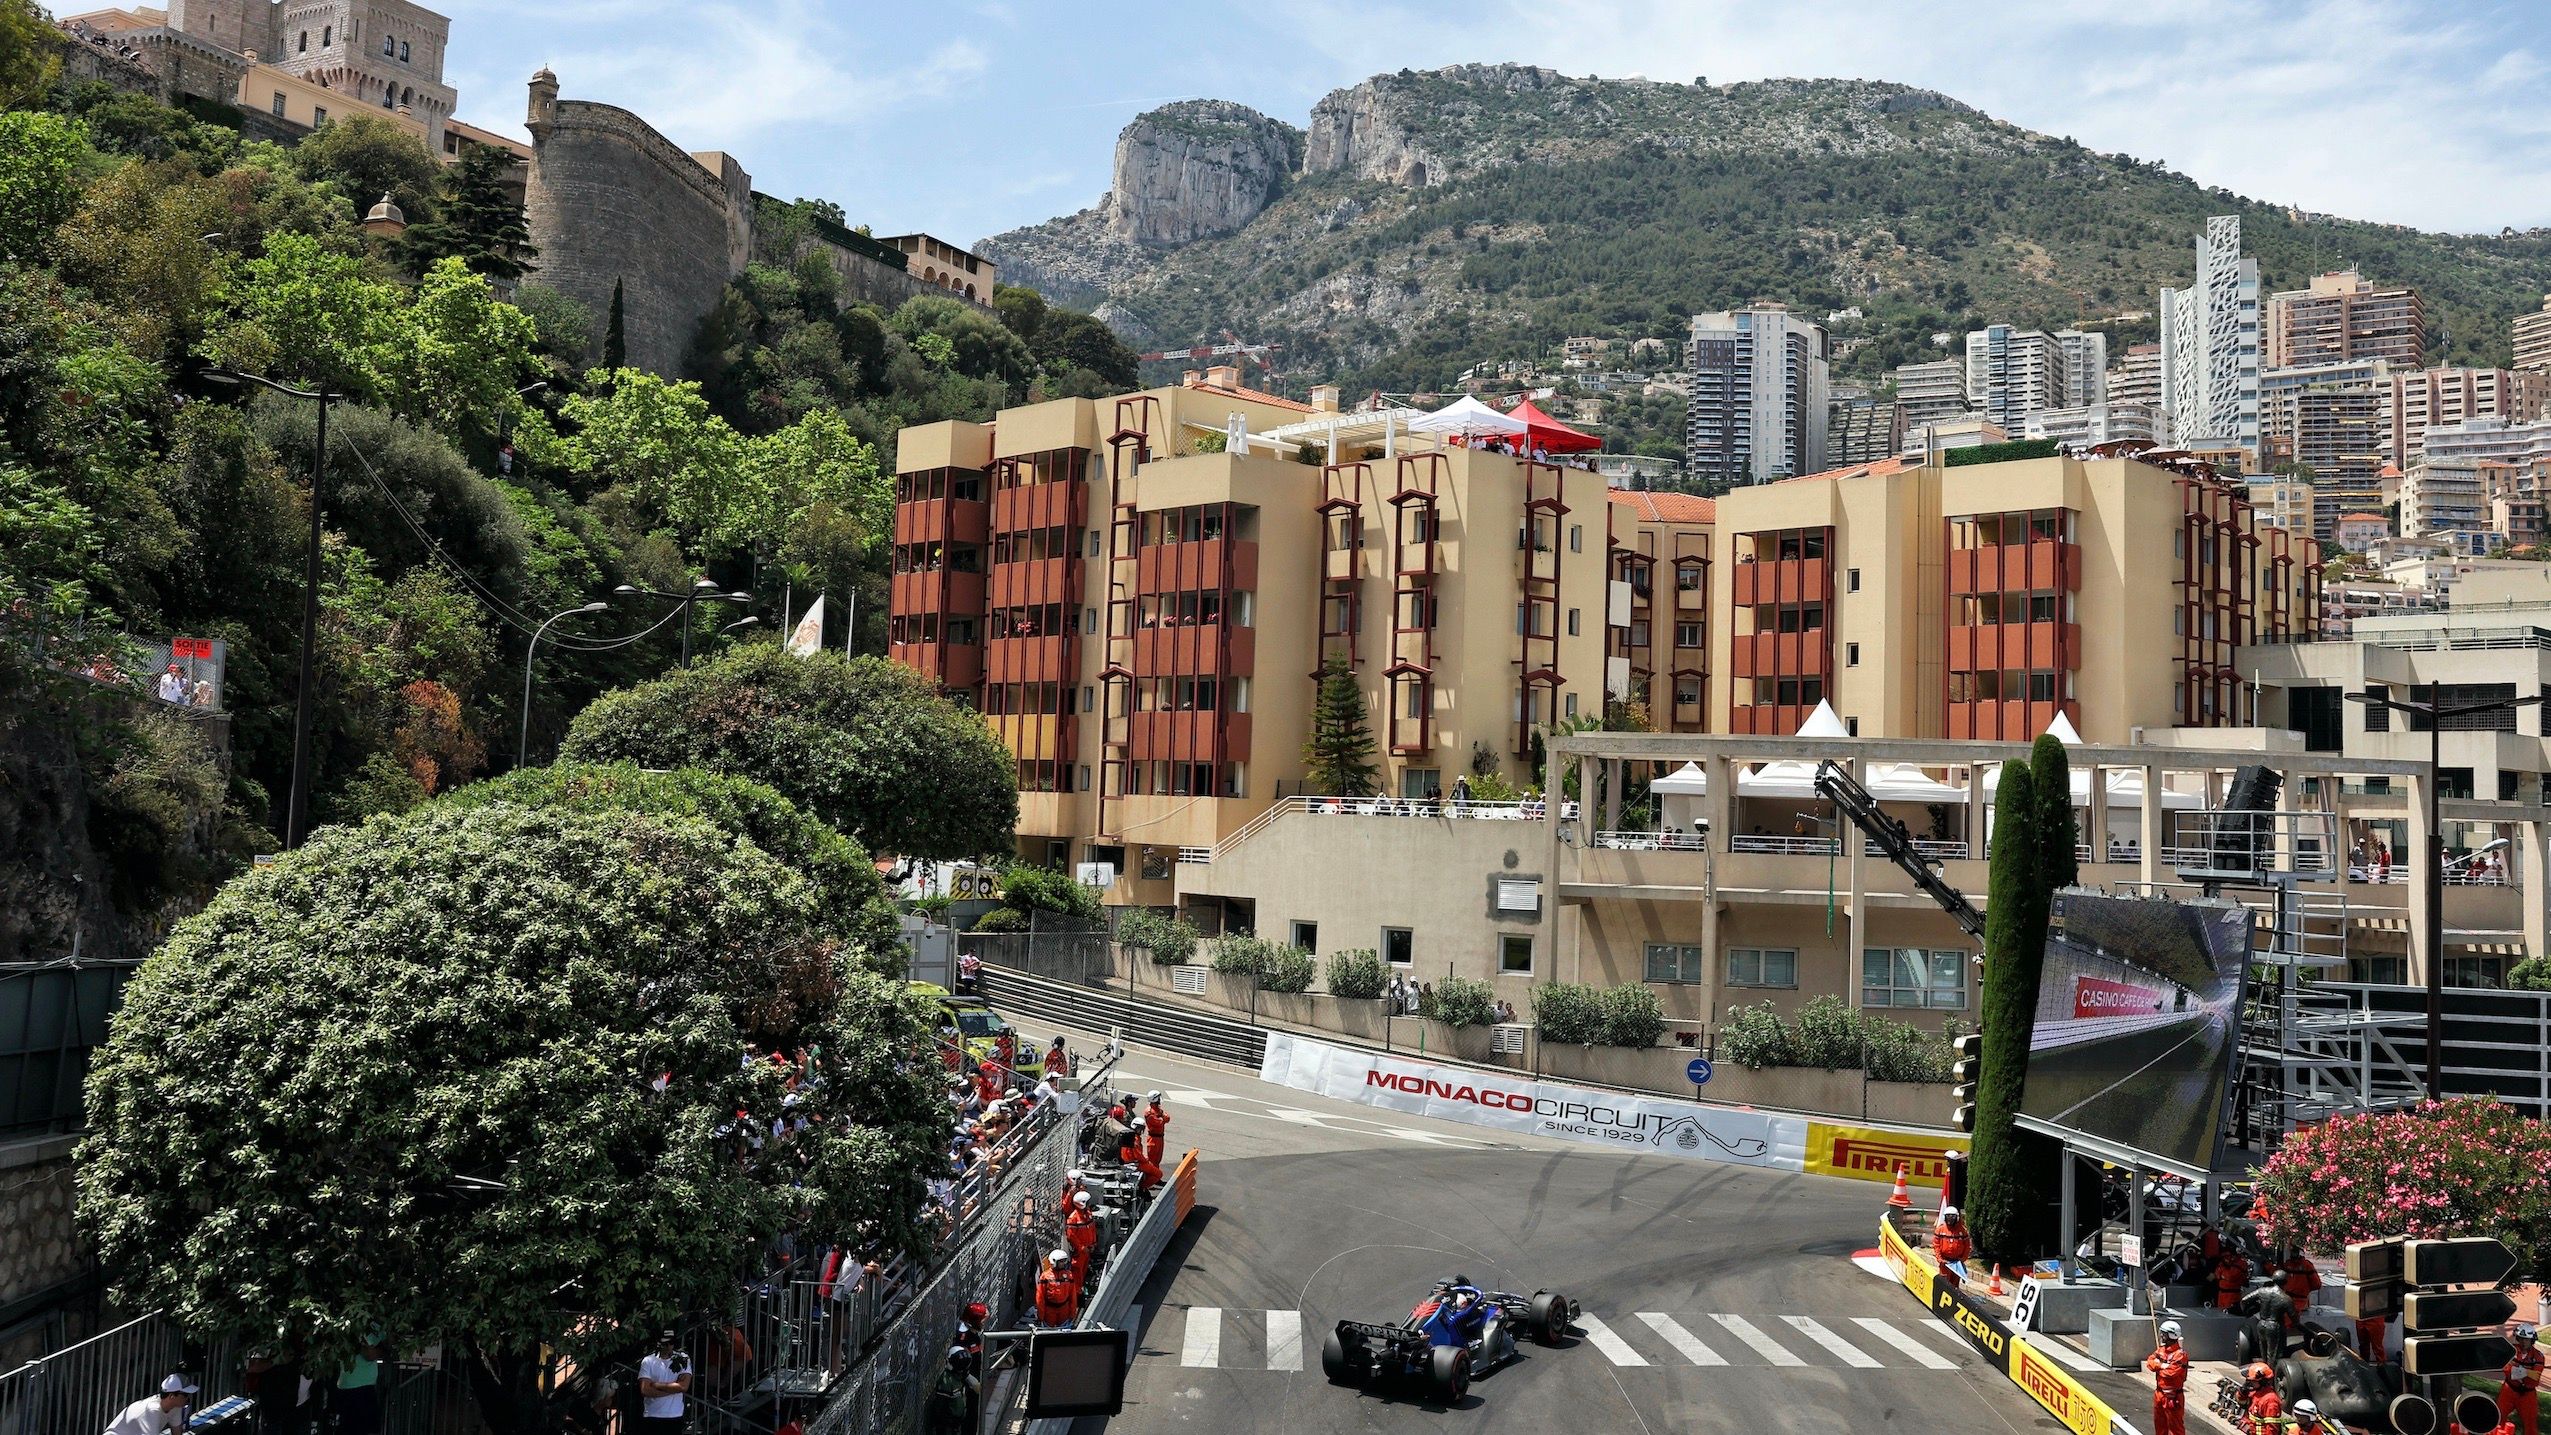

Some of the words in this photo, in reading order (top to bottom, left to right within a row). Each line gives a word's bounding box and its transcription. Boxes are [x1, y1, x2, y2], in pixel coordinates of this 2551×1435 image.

[2081, 989, 2119, 1008] CASINO
[1545, 1121, 1599, 1137] SINCE
[1603, 1129, 1645, 1143] 1929
[1832, 1137, 1964, 1178] PIRELL
[2015, 1283, 2036, 1323] SC
[1939, 1291, 1953, 1308] P
[1954, 1302, 2004, 1356] ZERO
[2021, 1351, 2069, 1418] PIRELLI
[2073, 1391, 2097, 1434] 150
